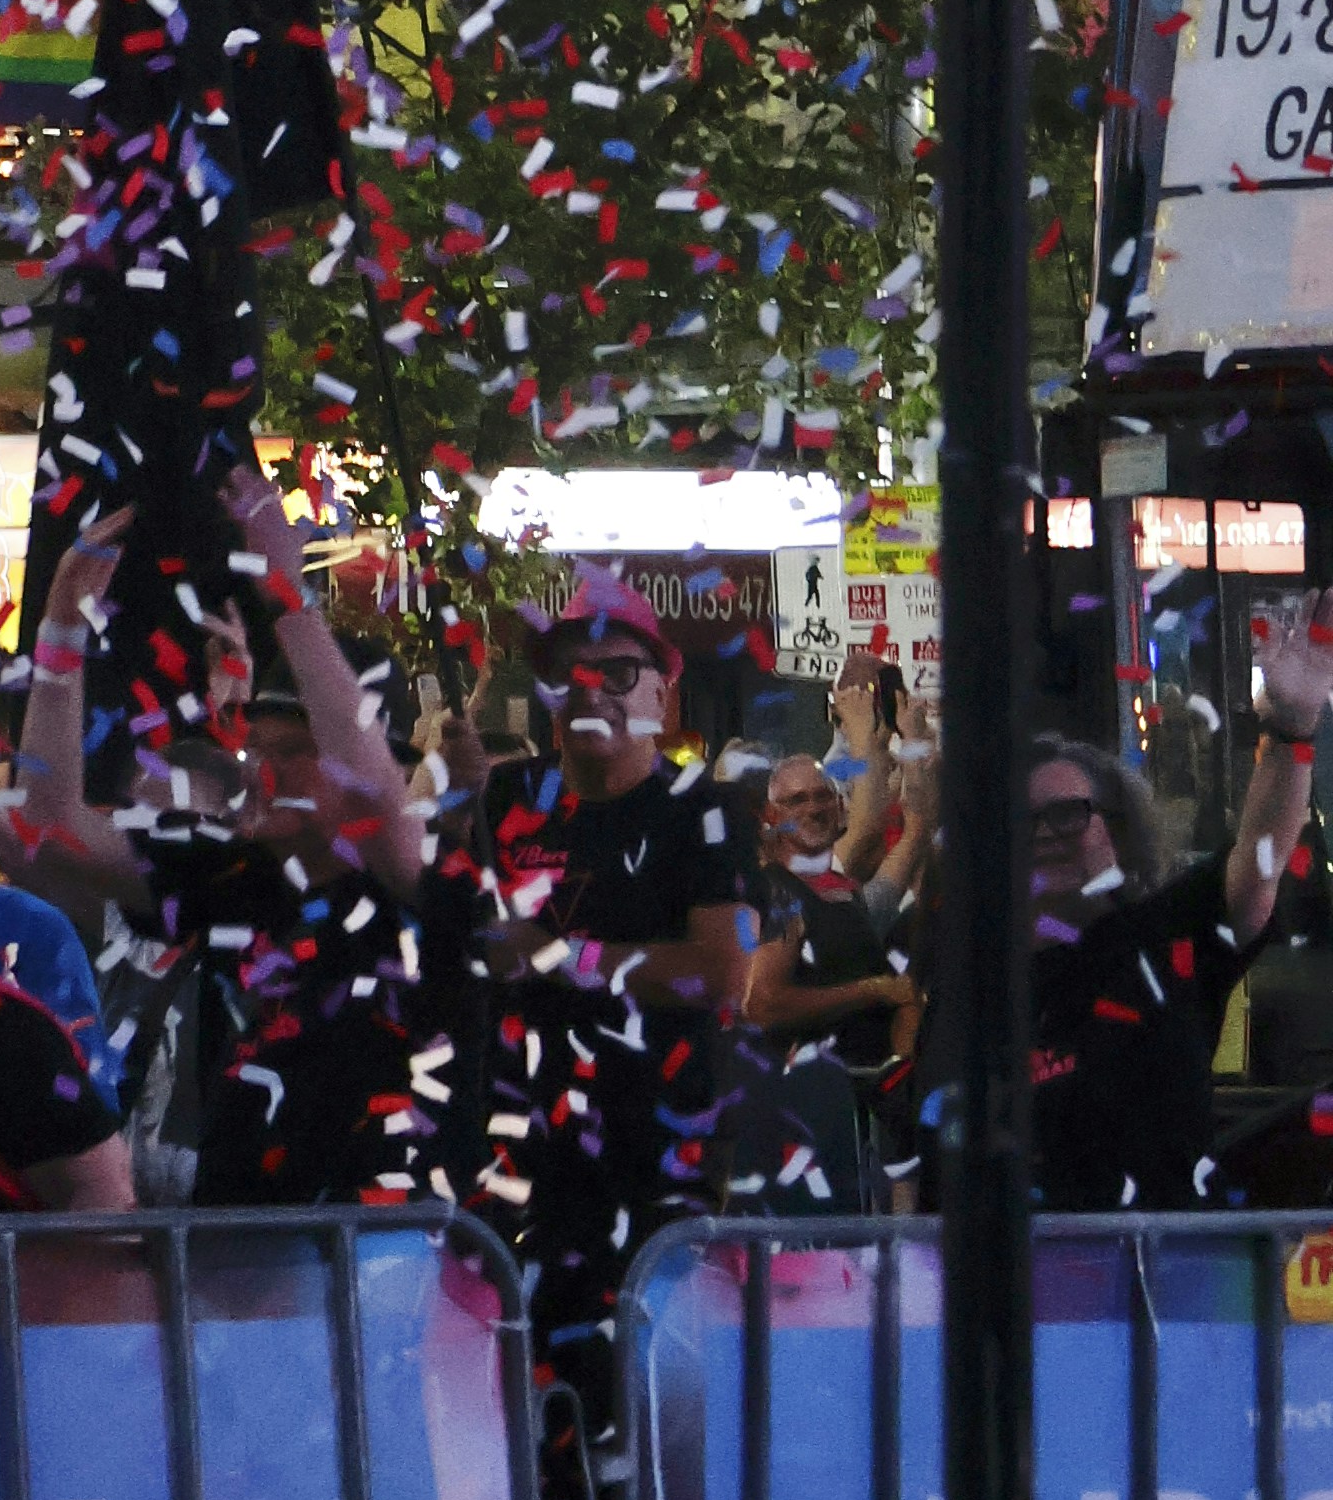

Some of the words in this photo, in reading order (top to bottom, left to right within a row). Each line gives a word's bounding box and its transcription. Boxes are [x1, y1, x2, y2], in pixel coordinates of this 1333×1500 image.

[903, 583, 940, 599] OTHE
[906, 602, 940, 618] TIME
[794, 654, 838, 674] END
